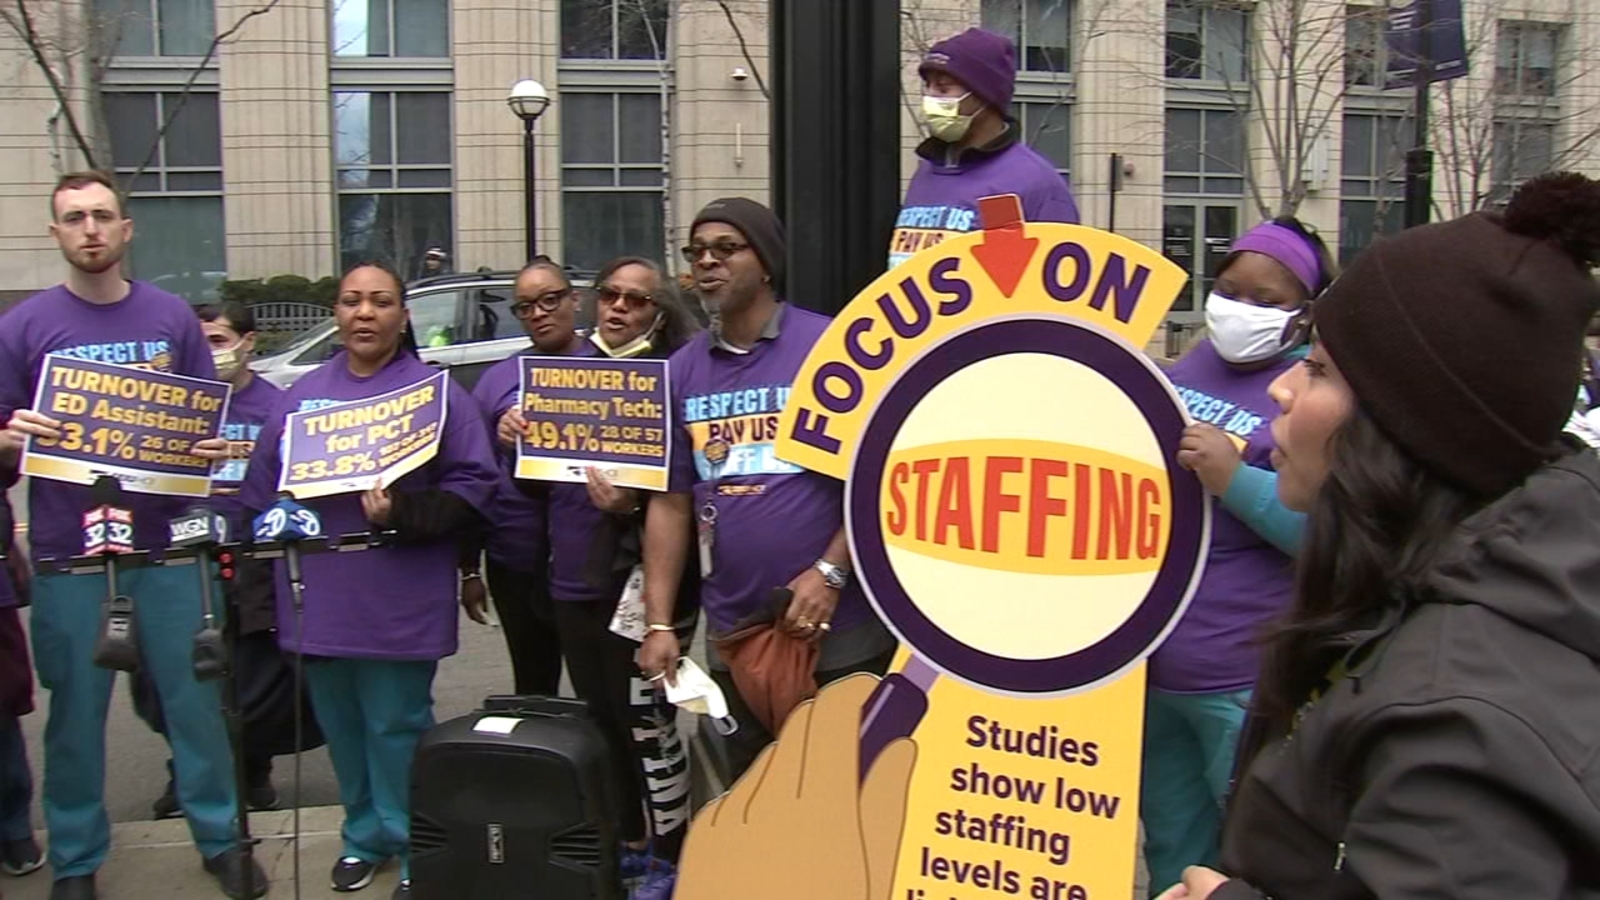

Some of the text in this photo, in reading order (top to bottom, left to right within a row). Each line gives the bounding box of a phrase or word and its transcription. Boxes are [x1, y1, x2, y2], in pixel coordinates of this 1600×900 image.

[946, 208, 975, 231] US
[50, 341, 138, 363] SPECT
[790, 241, 1151, 454] FOCUS ON
[52, 367, 222, 412] TURNOVER for
[531, 368, 657, 391] TURNOVER for
[52, 392, 87, 415] ED
[91, 399, 209, 435] Assistant:
[303, 385, 434, 435] TURNOVER
[524, 393, 663, 420] Pharmacy Tech:
[685, 387, 793, 421] RESPECT U
[326, 434, 364, 453] for
[367, 414, 414, 445] PCT
[526, 421, 600, 452] 49.1%
[621, 426, 642, 440] OF
[645, 428, 663, 441] 57
[709, 416, 778, 445] PAY US
[1224, 410, 1262, 435] US
[140, 435, 163, 449] 26
[167, 439, 191, 451] OF
[600, 440, 664, 457] WORKERS
[139, 449, 208, 468] WORKERS
[289, 452, 376, 480] 33.8%
[886, 456, 1161, 560] STAFFING
[108, 522, 132, 544] 32
[170, 516, 208, 536] WGN
[215, 515, 226, 543] 9
[966, 715, 1099, 766] Studies
[951, 762, 1120, 819] show low
[935, 809, 1070, 865] staffing
[921, 846, 1087, 900] levels are
